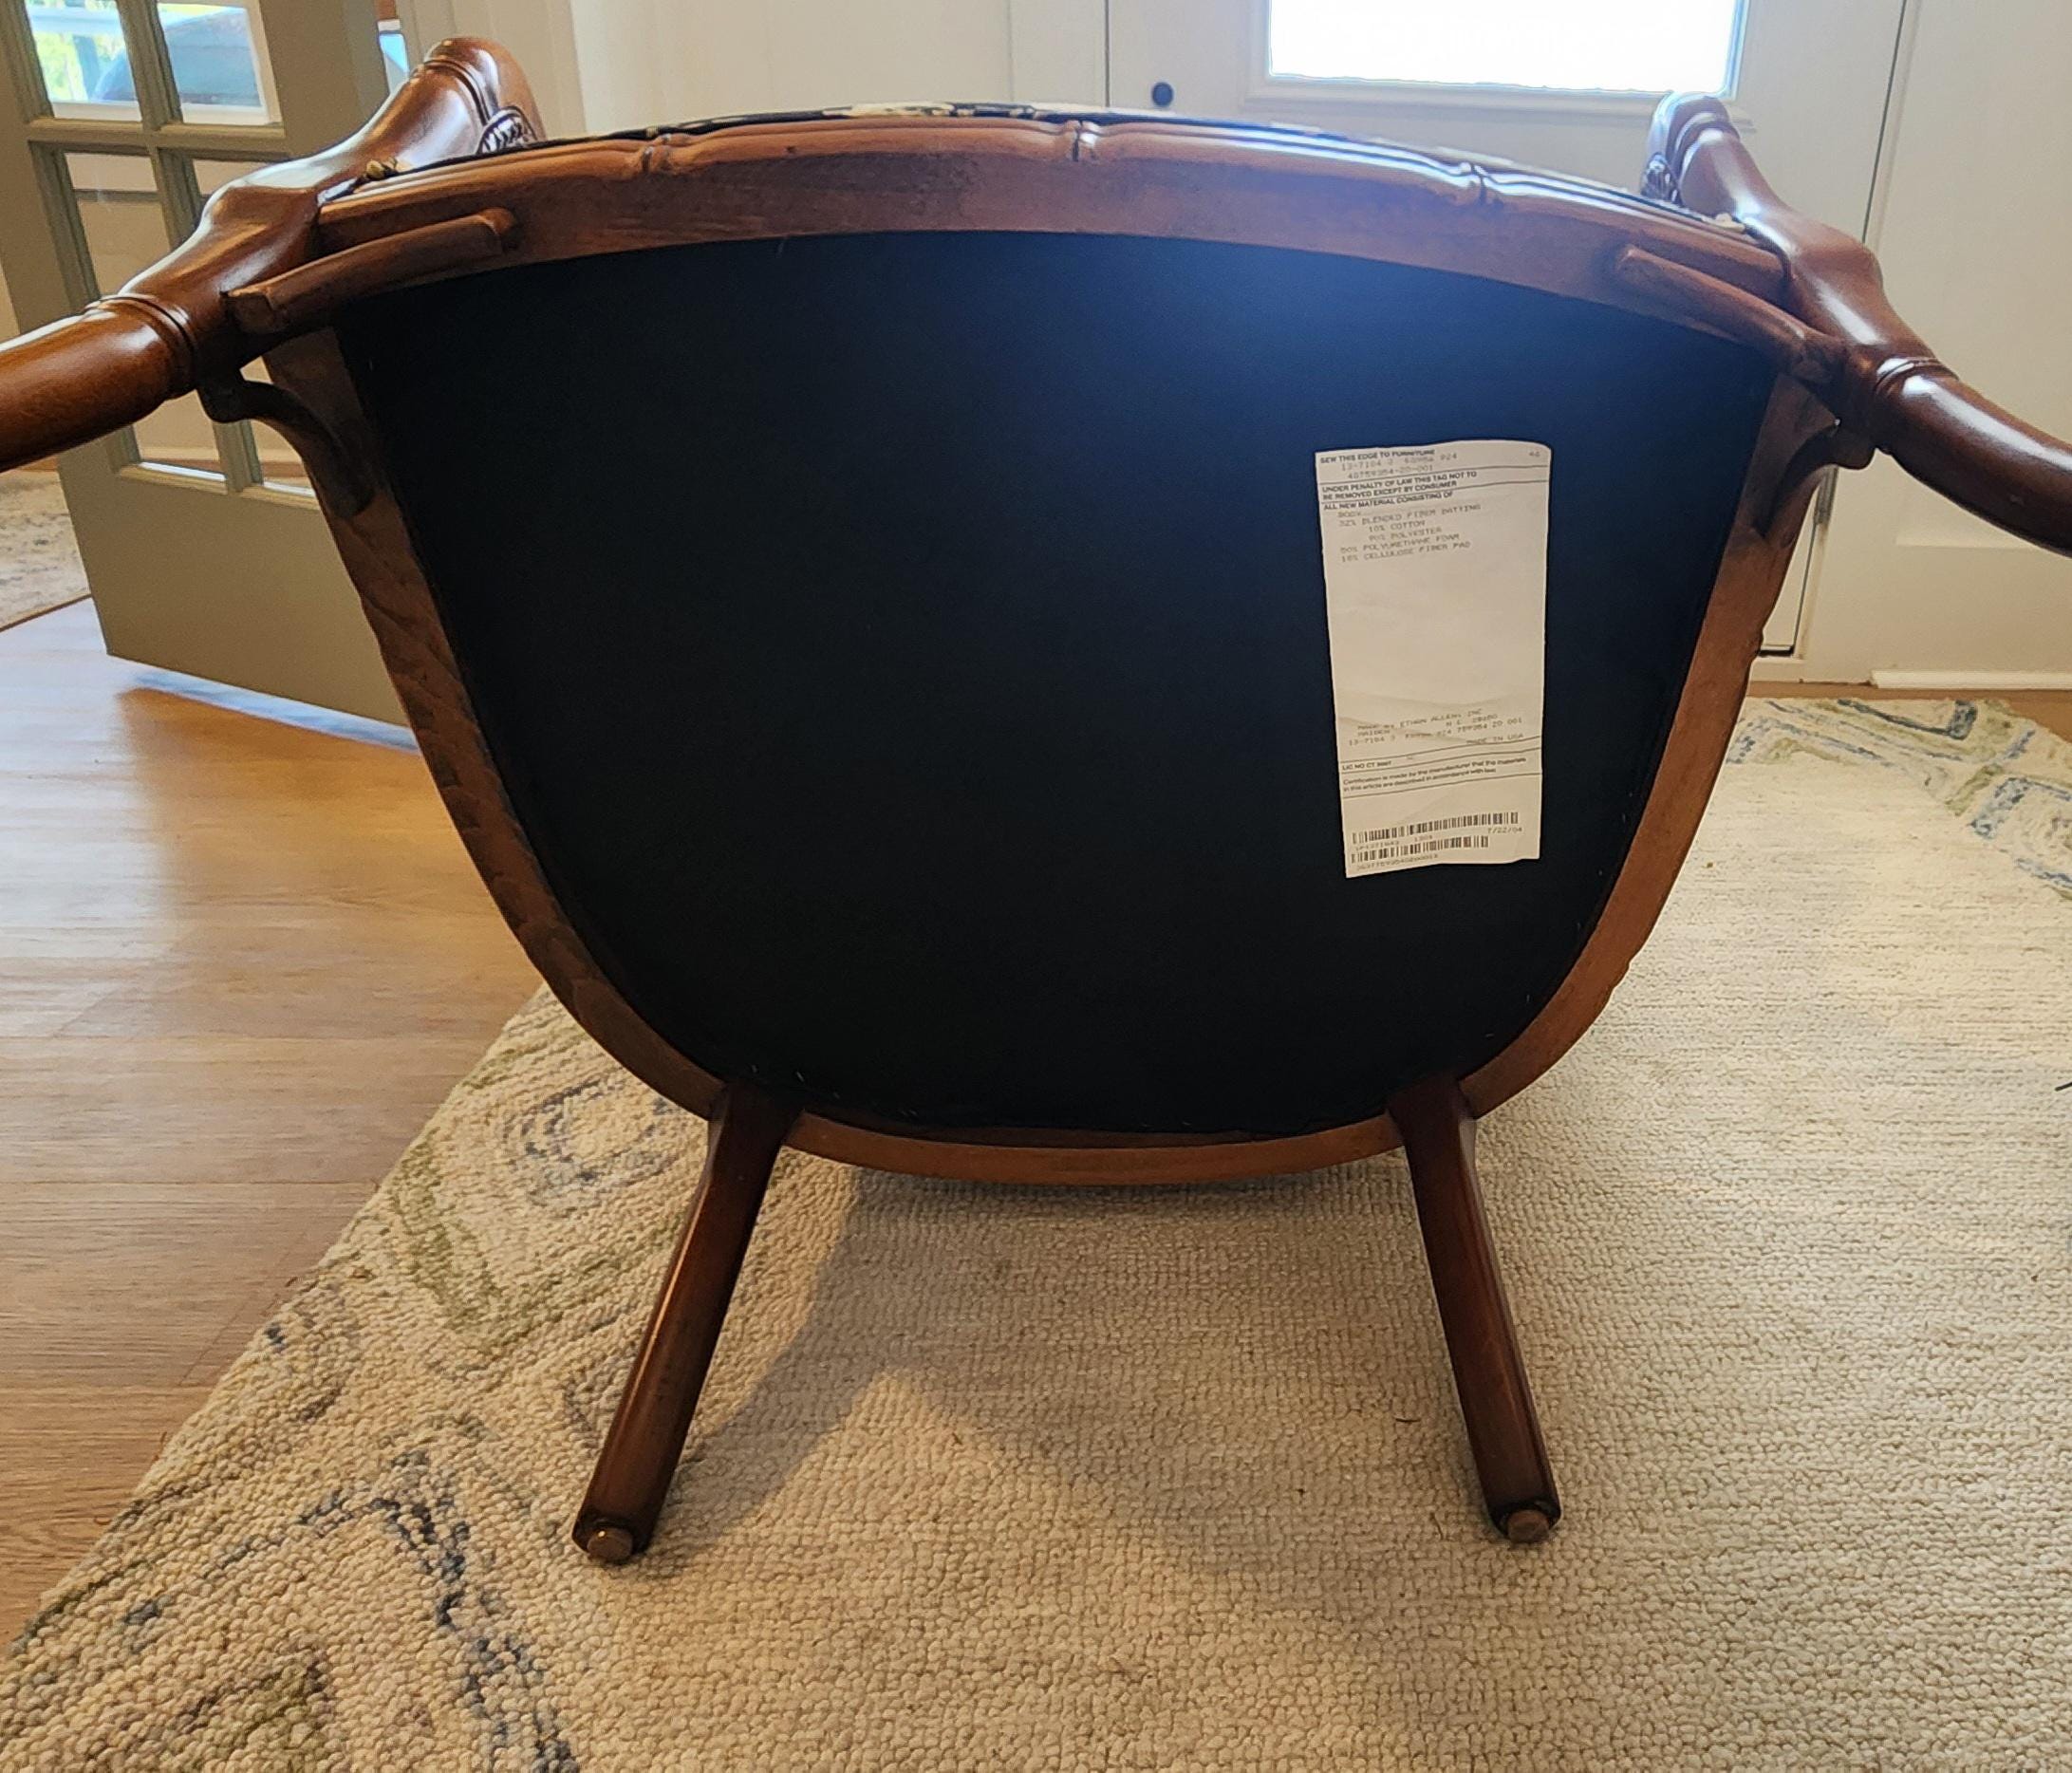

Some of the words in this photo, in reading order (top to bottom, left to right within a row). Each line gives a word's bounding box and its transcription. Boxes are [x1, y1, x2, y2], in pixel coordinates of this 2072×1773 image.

[1322, 485, 1349, 493] UNDER
[1351, 481, 1382, 490] PENALTY
[1335, 490, 1372, 499] REMOVED
[1415, 481, 1456, 491] CONSUMER
[1358, 499, 1395, 507] MATERIAL
[1397, 493, 1442, 504] CONSISTING
[1362, 514, 1402, 525] BLENDED
[1407, 510, 1436, 518] FIBER
[1391, 521, 1425, 530] COTTON
[1391, 527, 1442, 539] POLYESTER
[1363, 537, 1430, 551] POLYURETHANE
[1436, 533, 1459, 541] FOAM
[1364, 549, 1413, 560] CELLULOSE
[1419, 544, 1447, 552] FIBER
